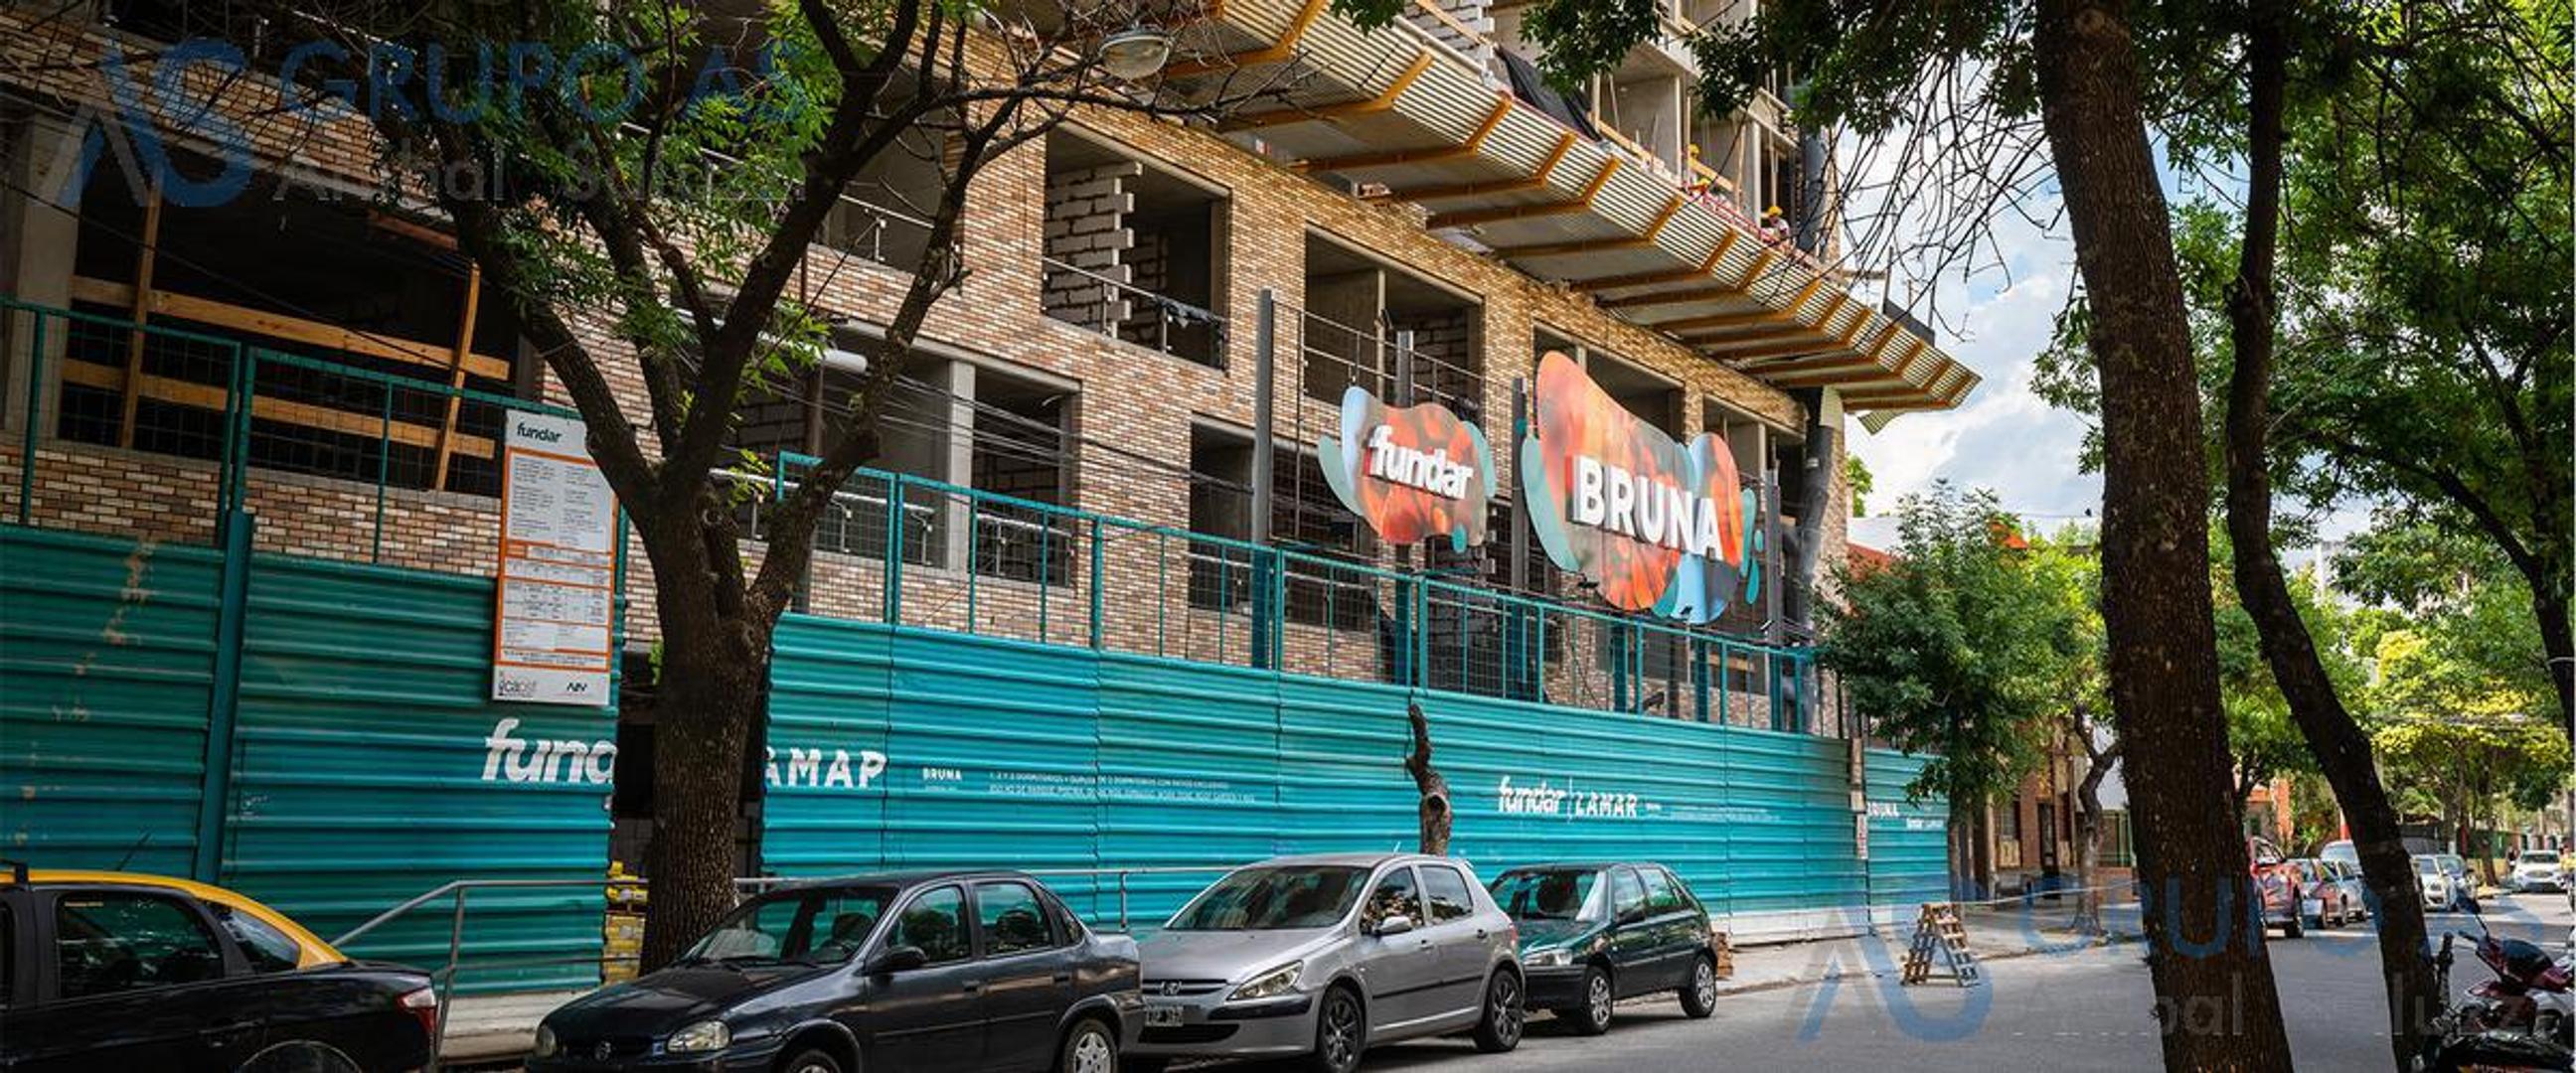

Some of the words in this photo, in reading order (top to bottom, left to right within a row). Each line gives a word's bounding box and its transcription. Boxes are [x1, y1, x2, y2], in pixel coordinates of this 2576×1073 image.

[518, 420, 564, 443] fundar
[1368, 425, 1474, 500] fundar
[1573, 453, 1723, 561] BRUNA
[922, 766, 962, 781] BRUNA
[1499, 775, 1566, 814] fundar
[1574, 791, 1638, 819] LAMAR
